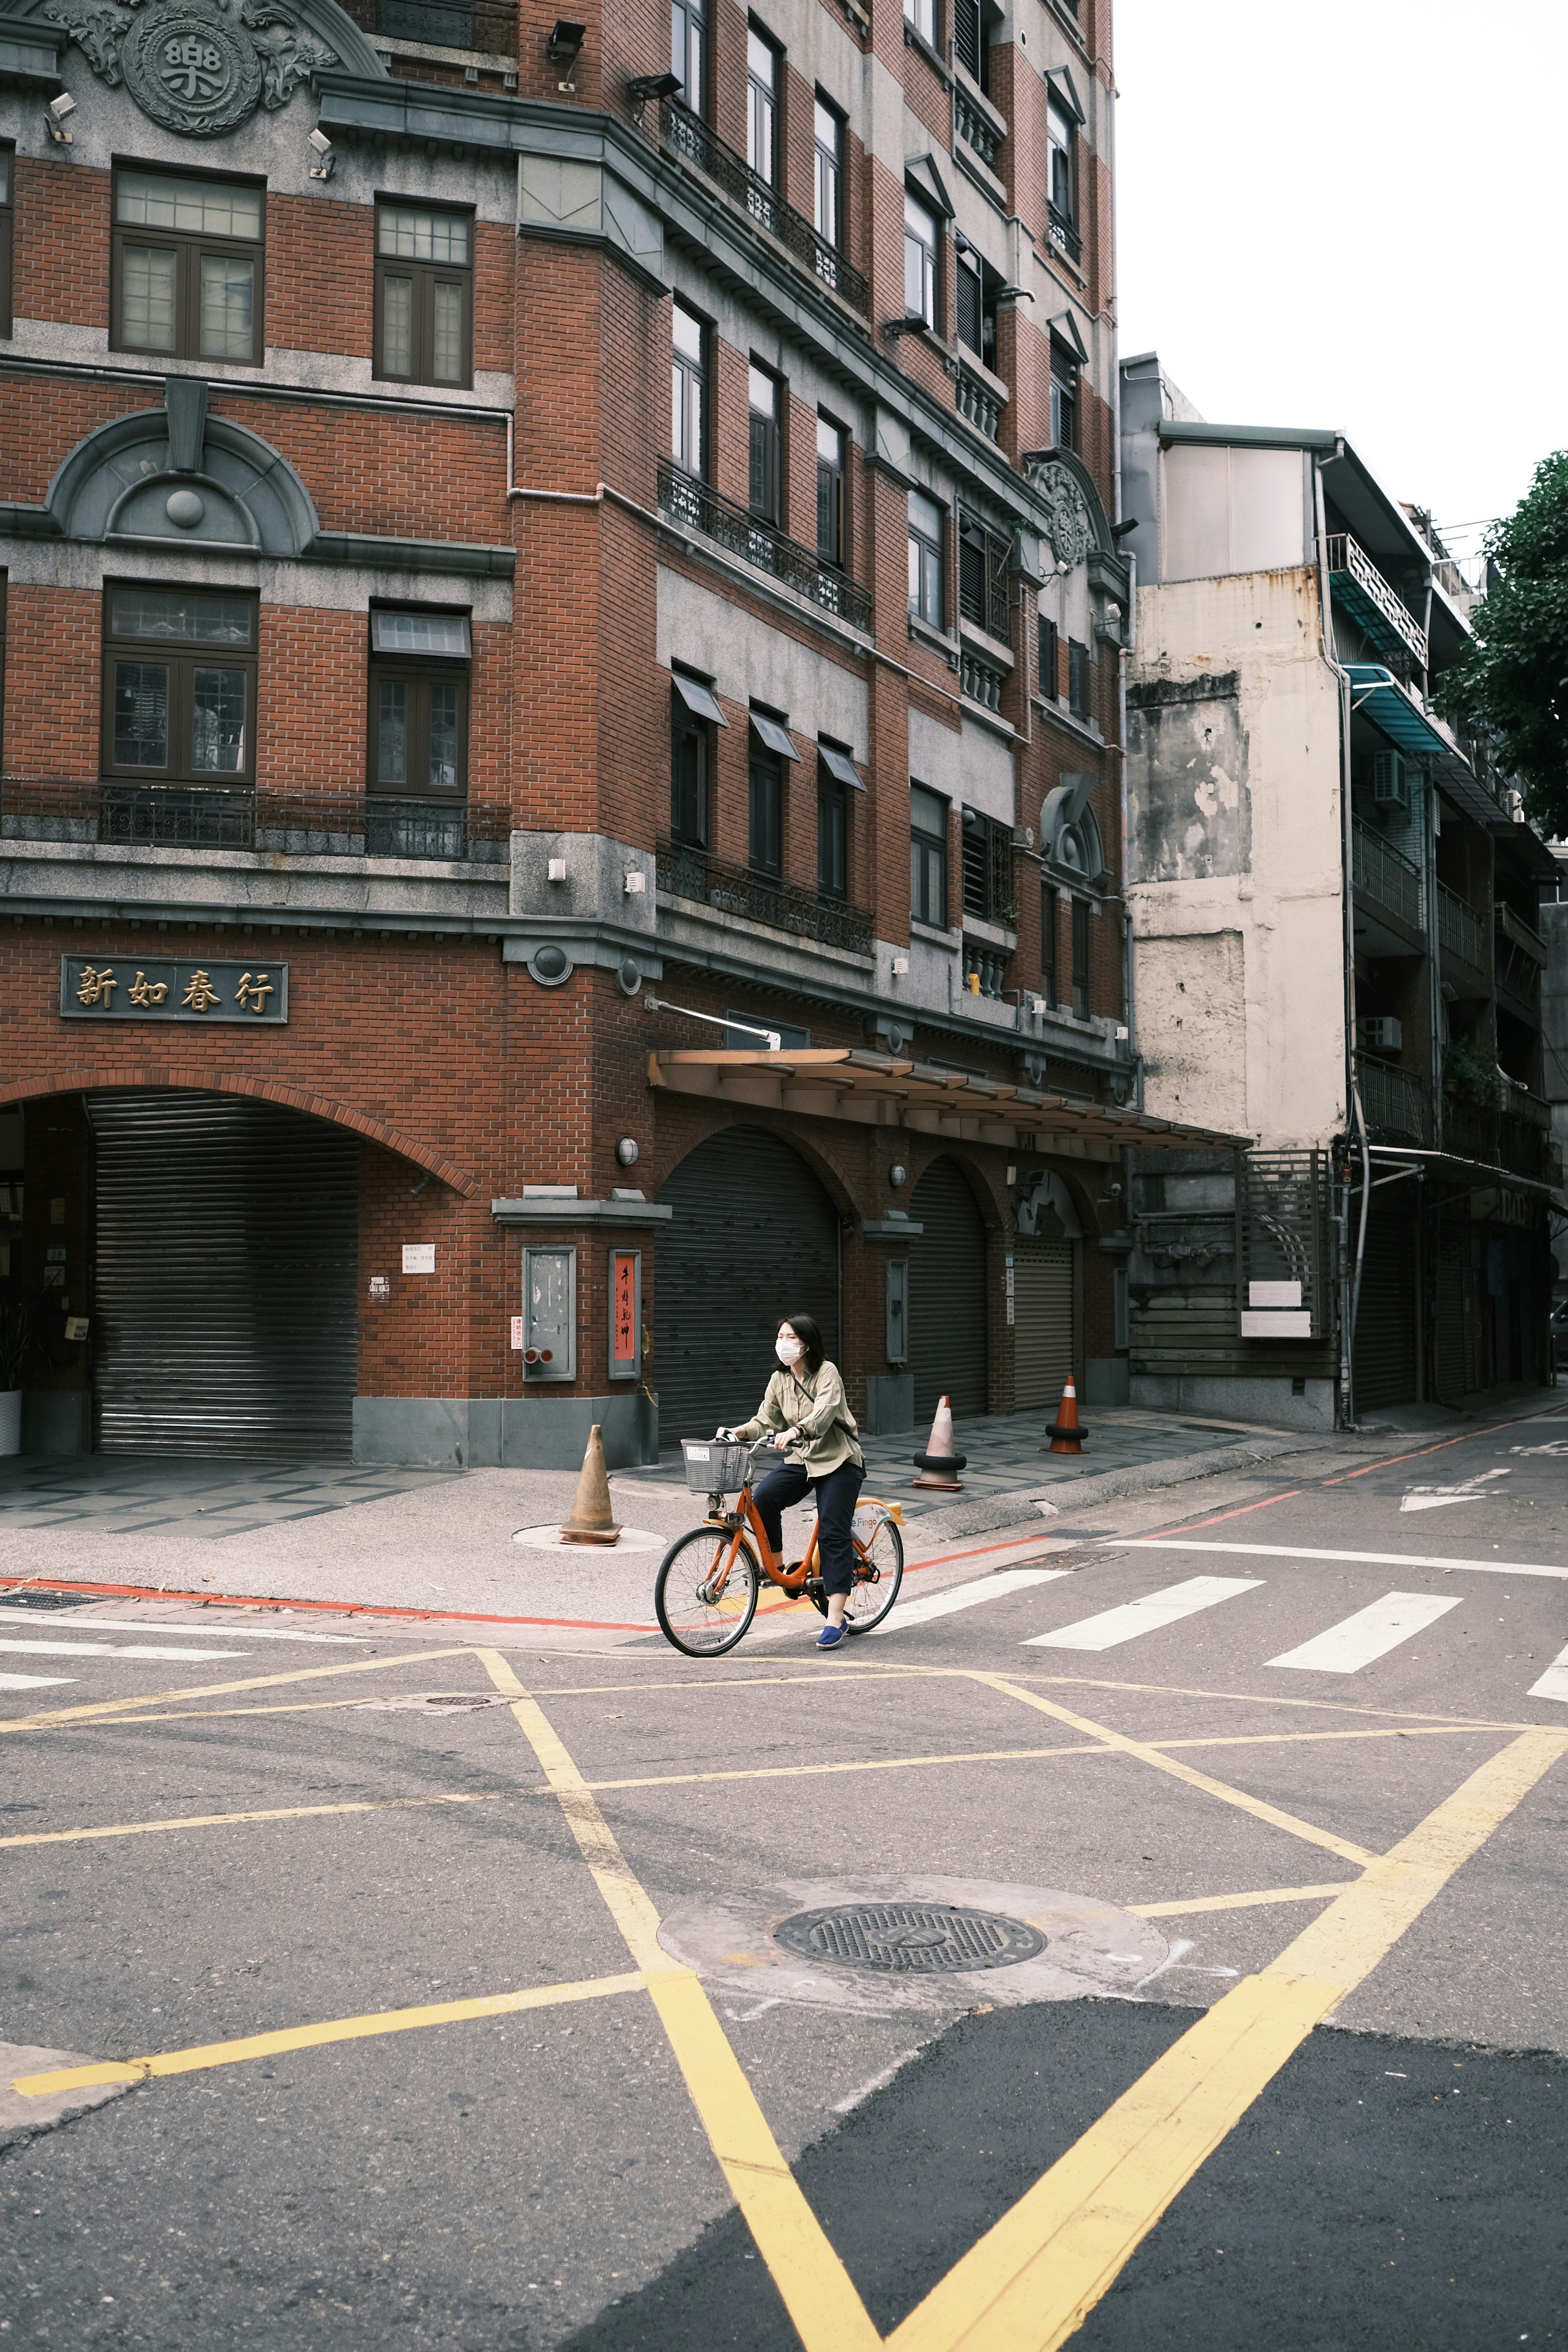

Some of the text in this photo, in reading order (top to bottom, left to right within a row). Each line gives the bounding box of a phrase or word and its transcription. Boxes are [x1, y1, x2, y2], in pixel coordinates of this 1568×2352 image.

[161, 35, 222, 99] 樂
[76, 965, 274, 1013] 新如春行
[51, 1250, 62, 1259] 39
